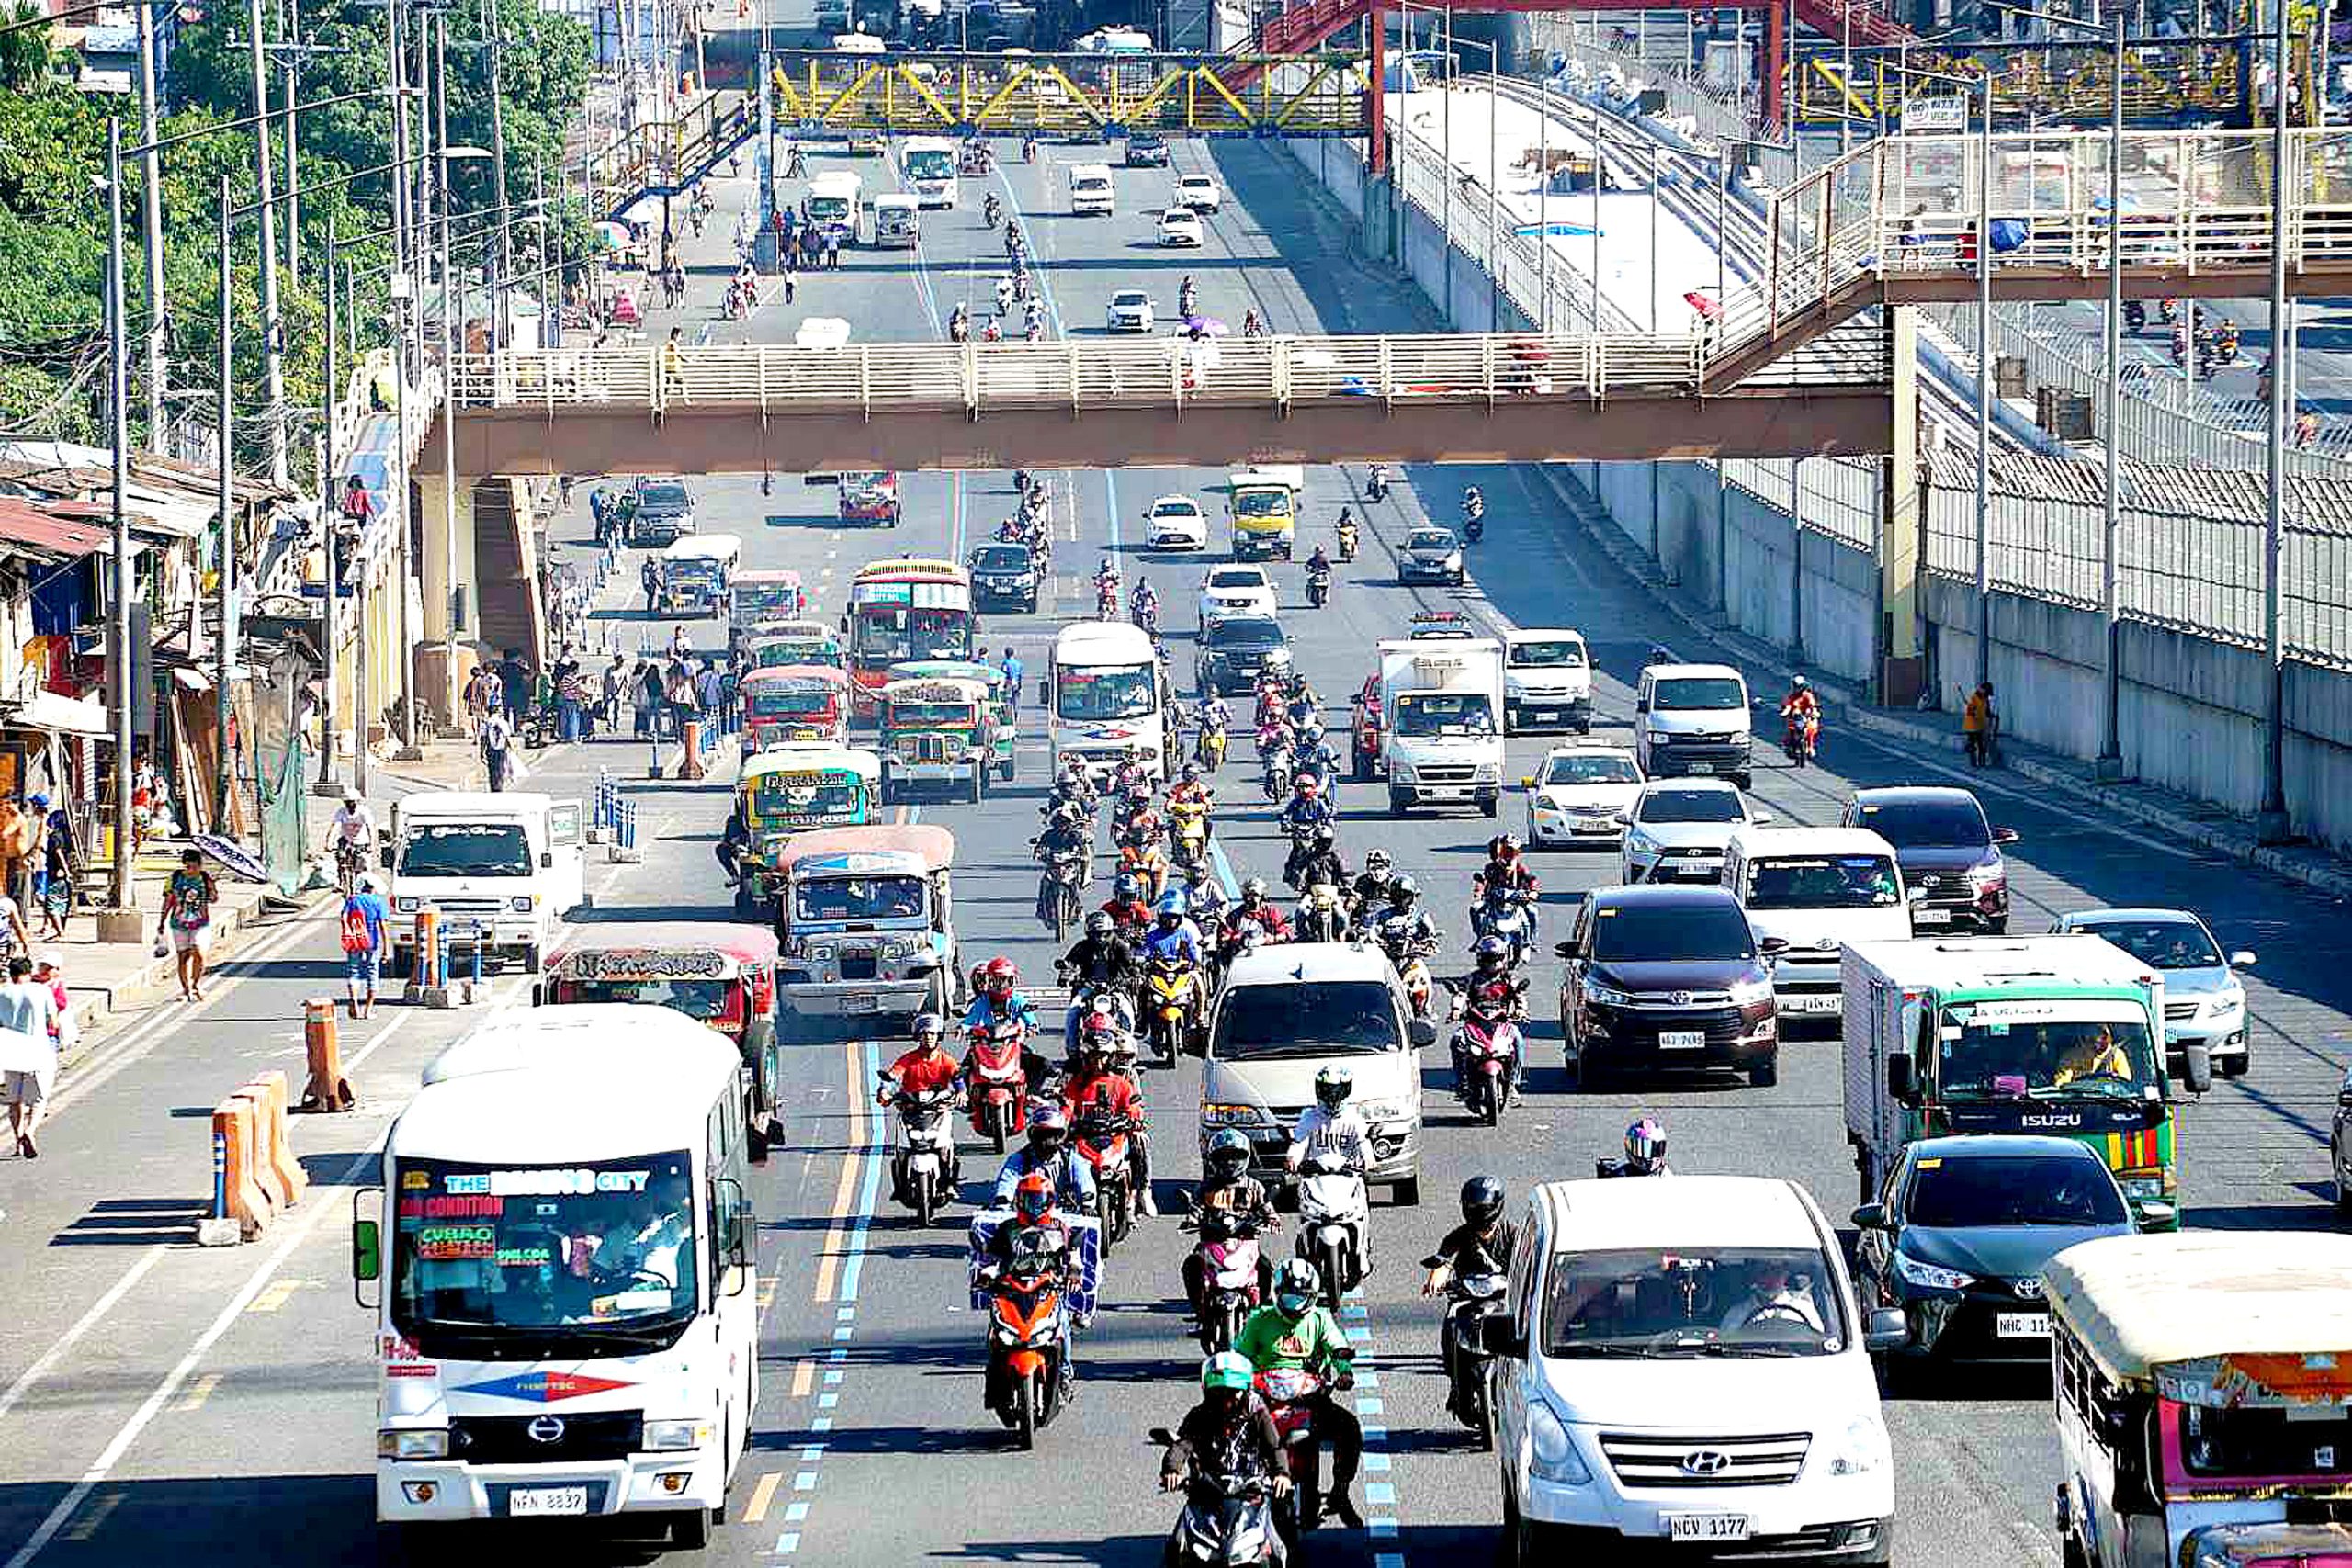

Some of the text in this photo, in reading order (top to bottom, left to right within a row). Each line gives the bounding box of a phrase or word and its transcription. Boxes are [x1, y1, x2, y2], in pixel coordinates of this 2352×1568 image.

[2022, 1114, 2081, 1126] ISUZU
[447, 1176, 488, 1191] THE
[597, 1172, 649, 1191] CITY
[426, 1196, 503, 1217] CONDITION
[423, 1228, 492, 1242] CUBAO
[1673, 1518, 1746, 1535] NCV 1177
